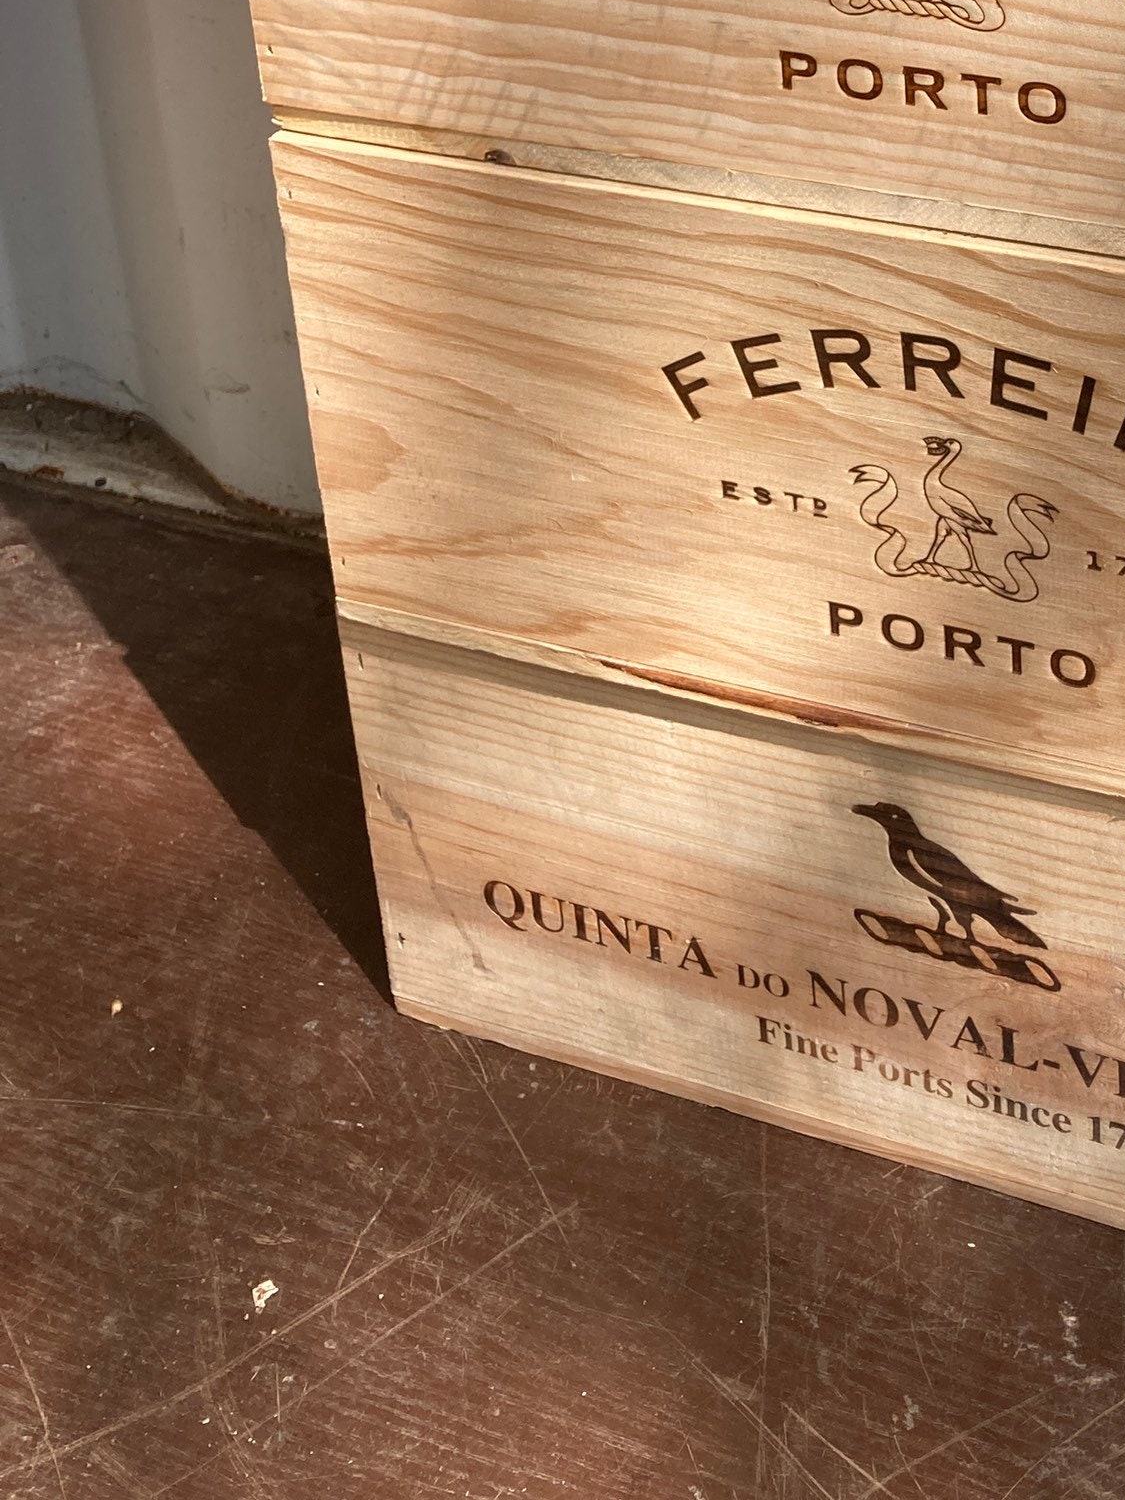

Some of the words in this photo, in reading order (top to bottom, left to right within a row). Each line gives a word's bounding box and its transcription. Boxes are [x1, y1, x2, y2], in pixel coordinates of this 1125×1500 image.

[778, 50, 1067, 124] PORTO
[721, 480, 828, 518] ESTD
[828, 601, 1097, 689] PORTO
[483, 879, 718, 979] QUINTA
[735, 963, 791, 998] DO
[756, 1015, 839, 1064] Fine
[850, 1043, 954, 1099] Ports
[965, 1078, 1073, 1134] Since
